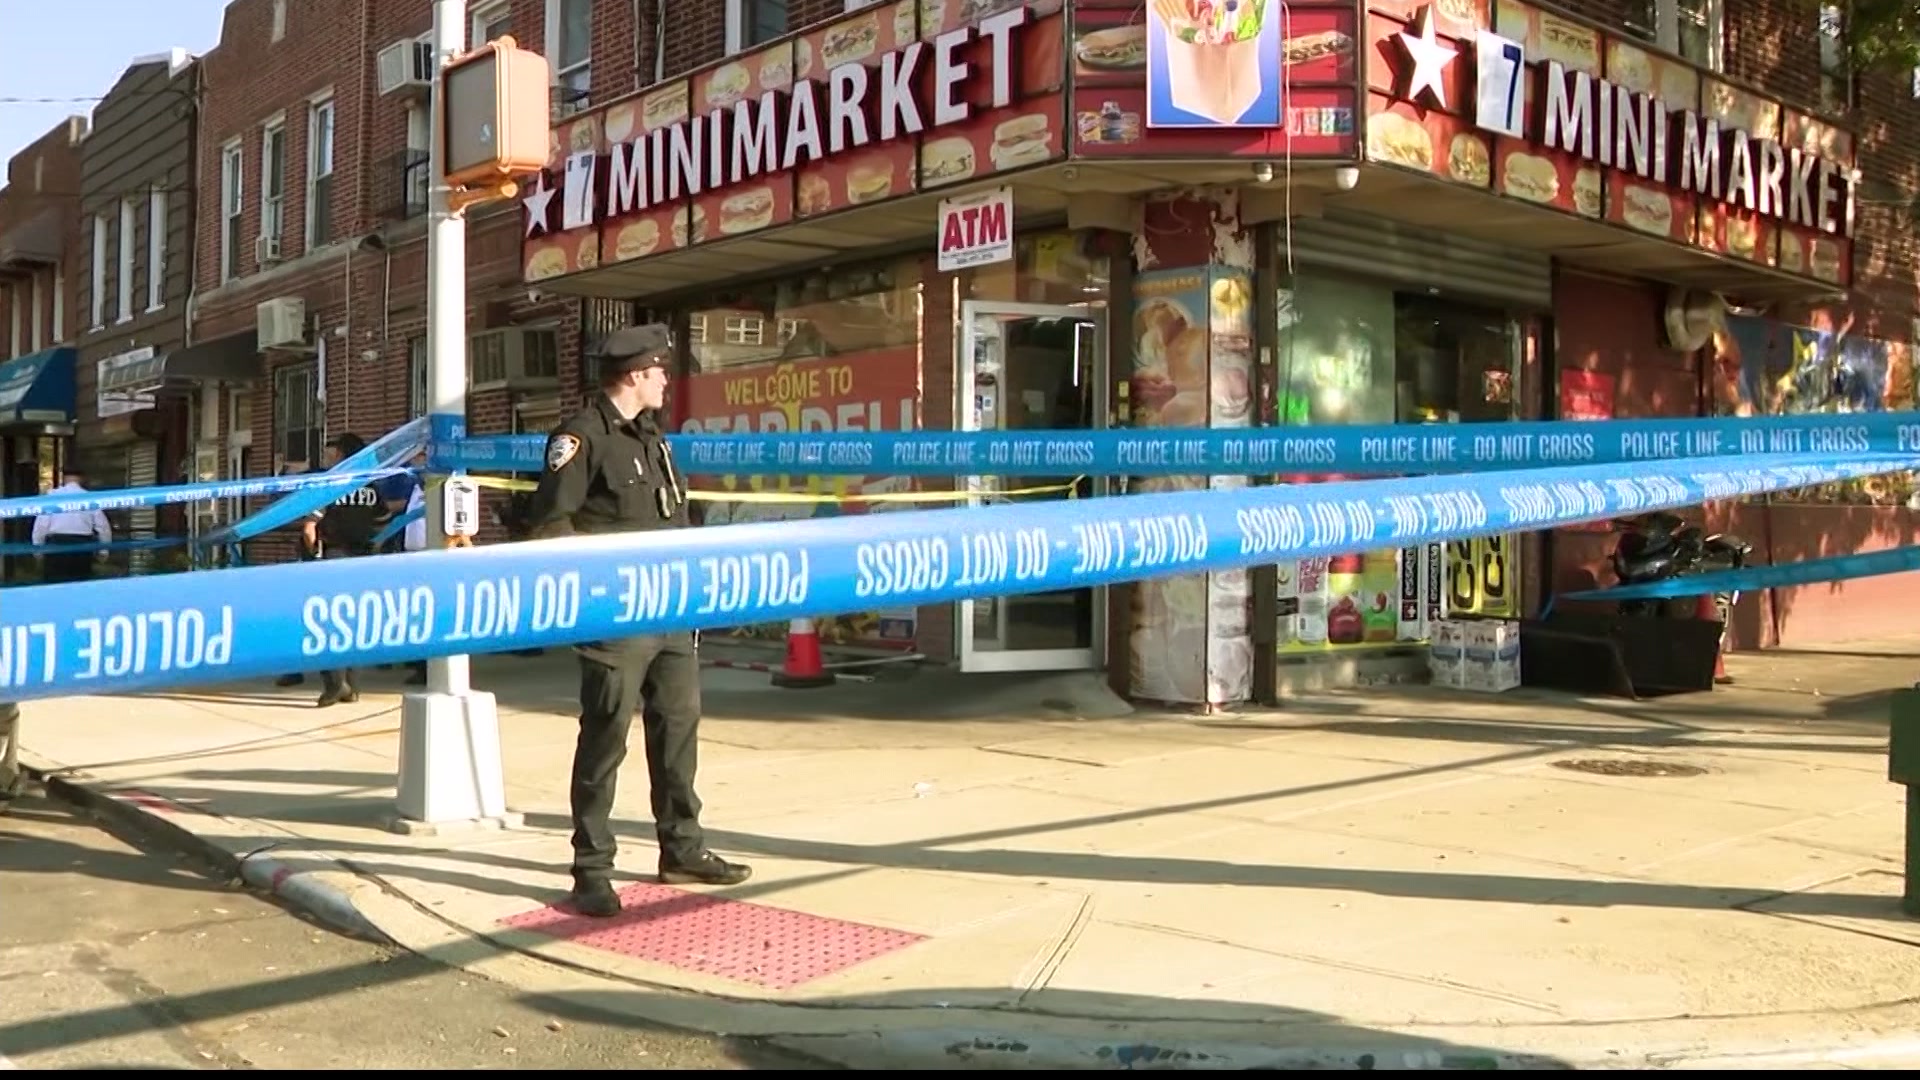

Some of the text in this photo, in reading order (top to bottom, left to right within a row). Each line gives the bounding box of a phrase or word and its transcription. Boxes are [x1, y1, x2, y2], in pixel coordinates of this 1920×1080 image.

[1545, 59, 1667, 183] MINI
[1681, 109, 1862, 238] MARKET
[942, 202, 1007, 252] ATM
[725, 365, 853, 405] WELCOME TO
[691, 441, 734, 464] POLICE
[737, 441, 766, 464] LINE
[777, 441, 796, 464] DO
[799, 441, 824, 464] NOT
[828, 442, 872, 465] CROSS
[893, 441, 941, 465] POLICE
[944, 441, 976, 465] LINE
[989, 441, 1009, 463] DO
[1013, 440, 1043, 465] NOT
[1045, 439, 1094, 465] CROSS
[1117, 439, 1170, 464] POLICE
[1174, 440, 1209, 463] LINE
[1223, 439, 1243, 463] DO
[1249, 439, 1280, 463] NOT
[1284, 438, 1336, 463] CROSS
[1361, 436, 1417, 463] POLICE
[1422, 436, 1457, 462] LINE
[1474, 435, 1497, 462] DO
[1501, 434, 1534, 462] NOT
[1539, 433, 1594, 461] CROSS
[1621, 431, 1681, 459] POLICE
[1809, 426, 1870, 452] CROSS
[1236, 503, 1305, 554] CROSS
[1307, 500, 1346, 548] NOT
[1346, 499, 1376, 543] DO
[1423, 490, 1488, 532] POLICE
[953, 530, 1008, 587] NOT
[1015, 527, 1049, 580] DO
[1072, 520, 1126, 574] LINE
[1130, 513, 1209, 567] POLICE
[613, 558, 690, 624] LINE
[696, 548, 809, 615] POLICE
[855, 538, 949, 598] CROSS
[301, 584, 435, 657] CROSS
[444, 575, 521, 642] NOT
[531, 568, 581, 632] DO
[73, 604, 234, 679] POLICE
